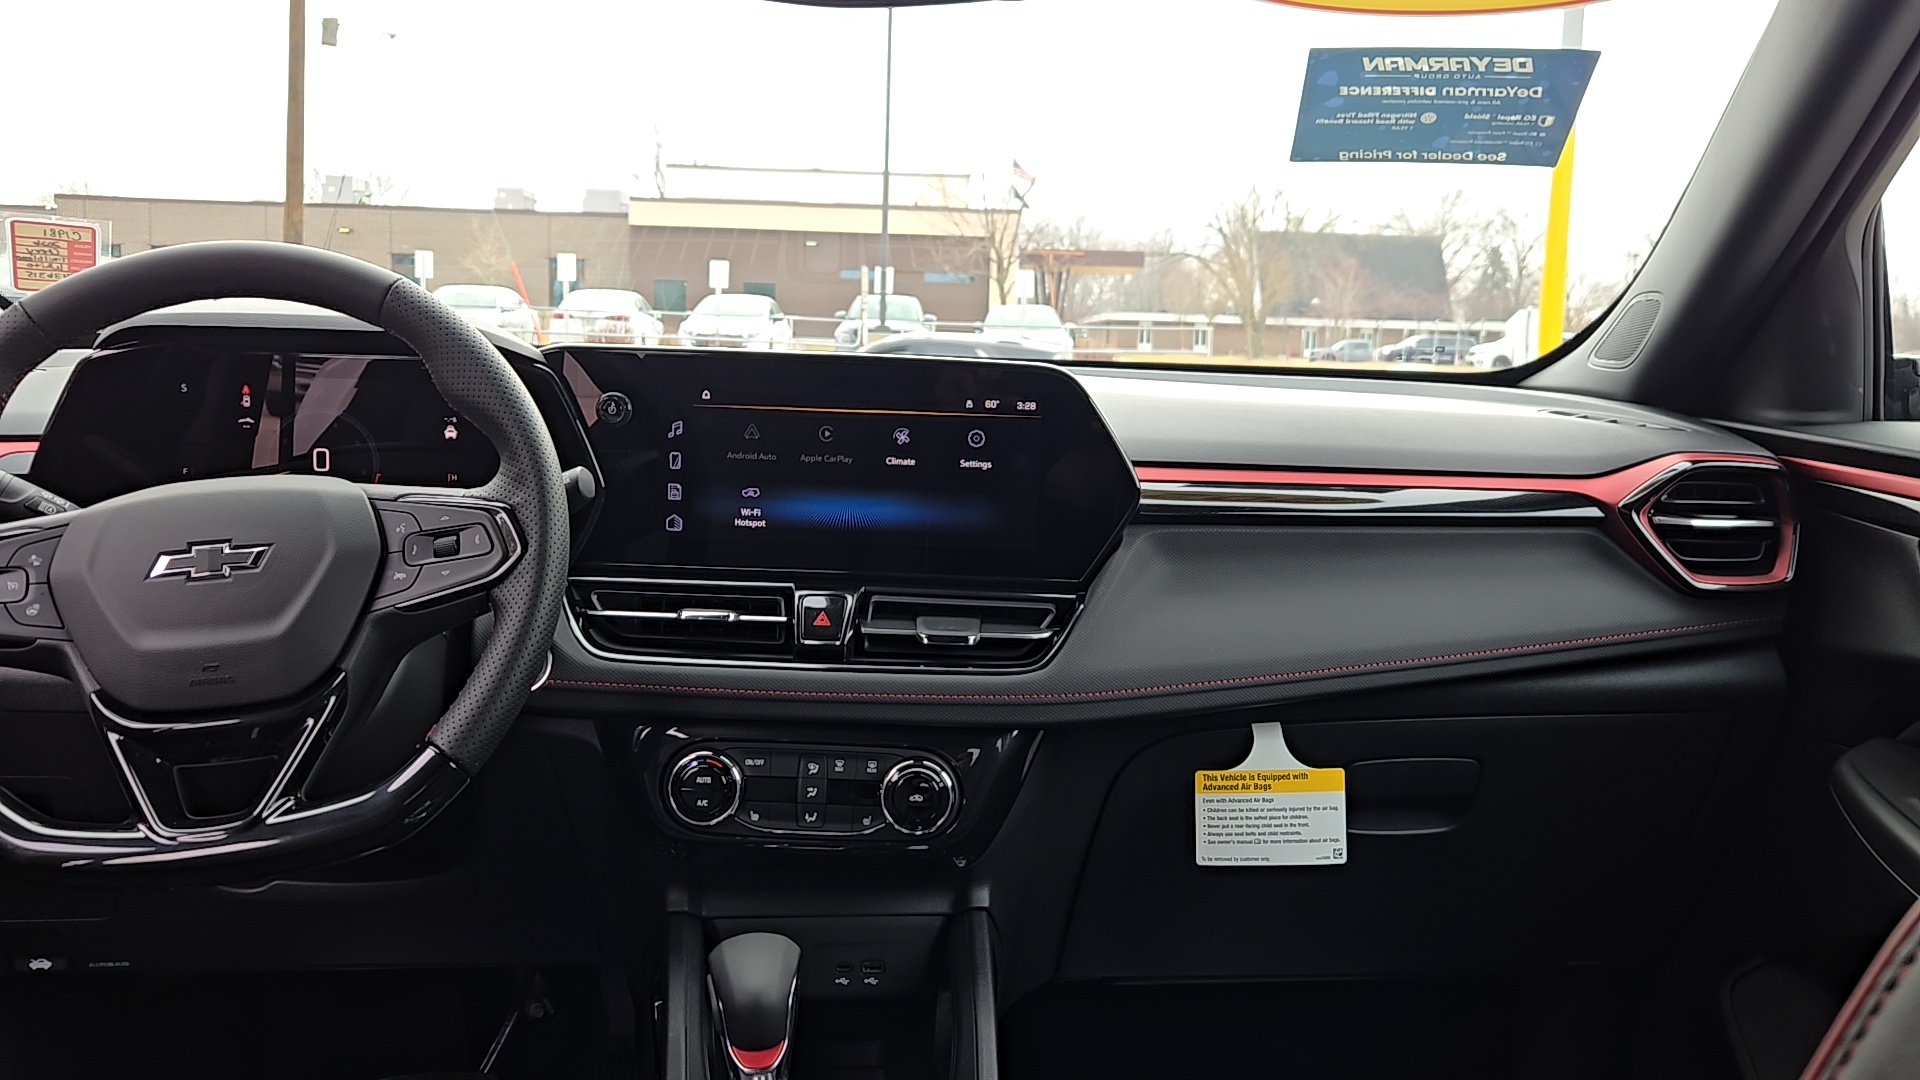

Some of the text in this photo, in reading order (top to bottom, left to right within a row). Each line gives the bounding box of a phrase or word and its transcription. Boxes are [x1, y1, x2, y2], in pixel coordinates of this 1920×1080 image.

[180, 384, 188, 393] S
[1016, 402, 1036, 411] 3:28
[312, 448, 330, 472] 0
[726, 452, 777, 462] Android Auto
[800, 454, 854, 465] Apple CarPlay
[886, 456, 916, 466] Climate
[960, 458, 992, 470] Settings
[182, 468, 188, 476] F
[740, 508, 762, 518] Wi-Fi
[734, 518, 767, 529] Hotspot
[1202, 772, 1308, 782] This Vehicle is Equipped with
[1202, 783, 1239, 791] Advanced
[1254, 783, 1272, 791] Bags
[696, 799, 709, 807] A/C
